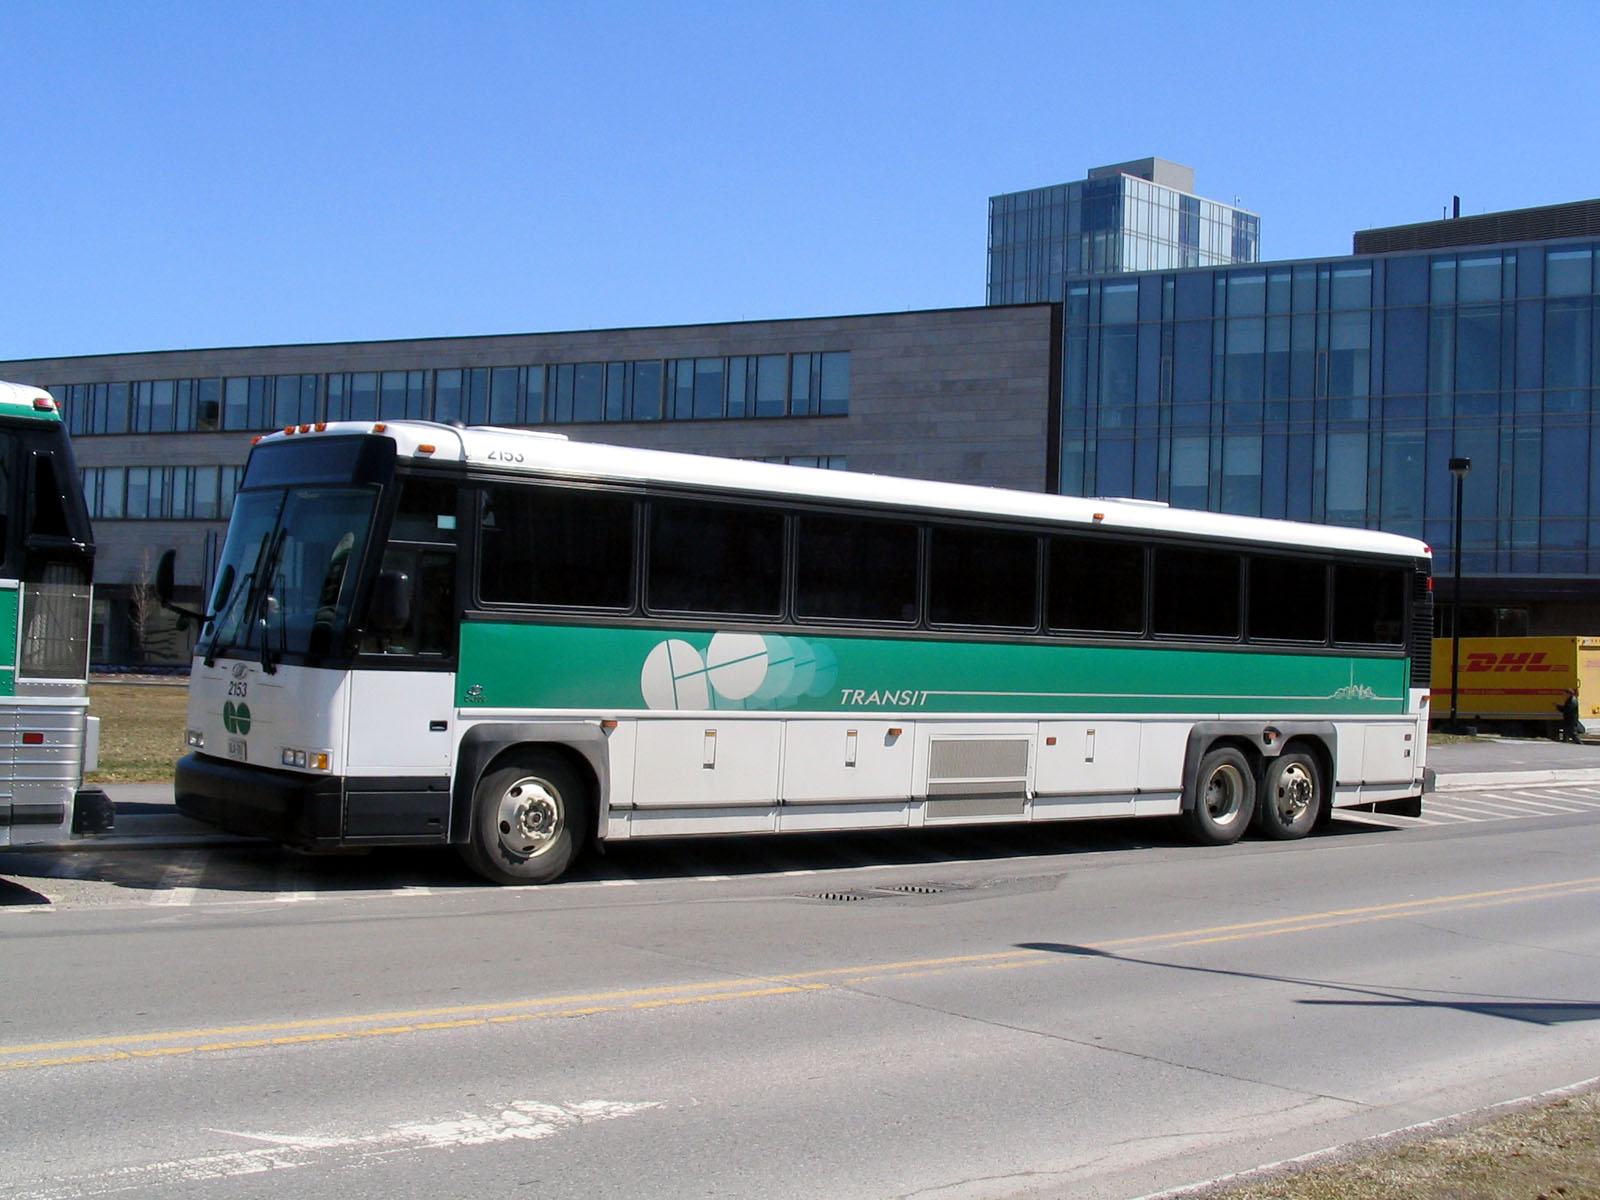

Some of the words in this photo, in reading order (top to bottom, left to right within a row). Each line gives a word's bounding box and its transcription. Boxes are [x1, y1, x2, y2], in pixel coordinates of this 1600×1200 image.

[487, 450, 525, 463] 2153
[1466, 652, 1552, 672] DHL
[228, 681, 248, 697] 2153
[840, 689, 929, 706] TRANSIT
